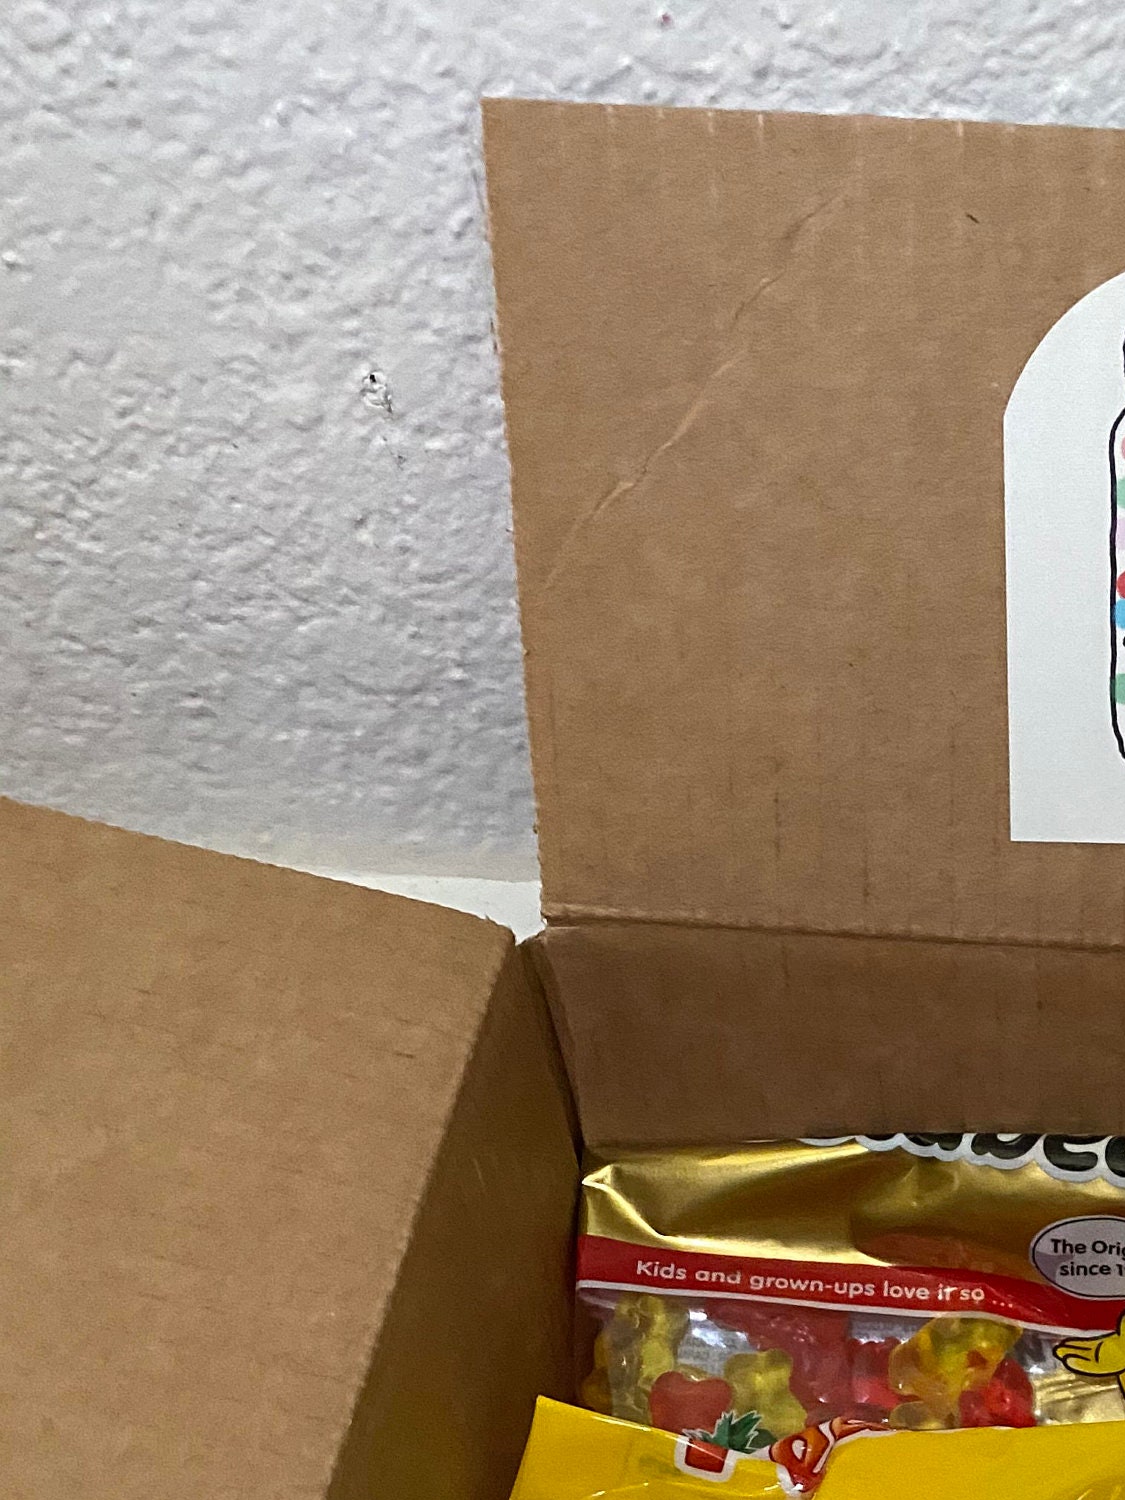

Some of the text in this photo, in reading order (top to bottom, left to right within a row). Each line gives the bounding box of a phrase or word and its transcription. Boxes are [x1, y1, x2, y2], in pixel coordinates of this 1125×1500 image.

[1050, 1238, 1087, 1255] The
[1060, 1262, 1111, 1277] since
[637, 1259, 687, 1281] Kids
[695, 1267, 742, 1285] and
[749, 1271, 876, 1298] grown-ups
[882, 1280, 930, 1300] love
[959, 1286, 986, 1302] so
